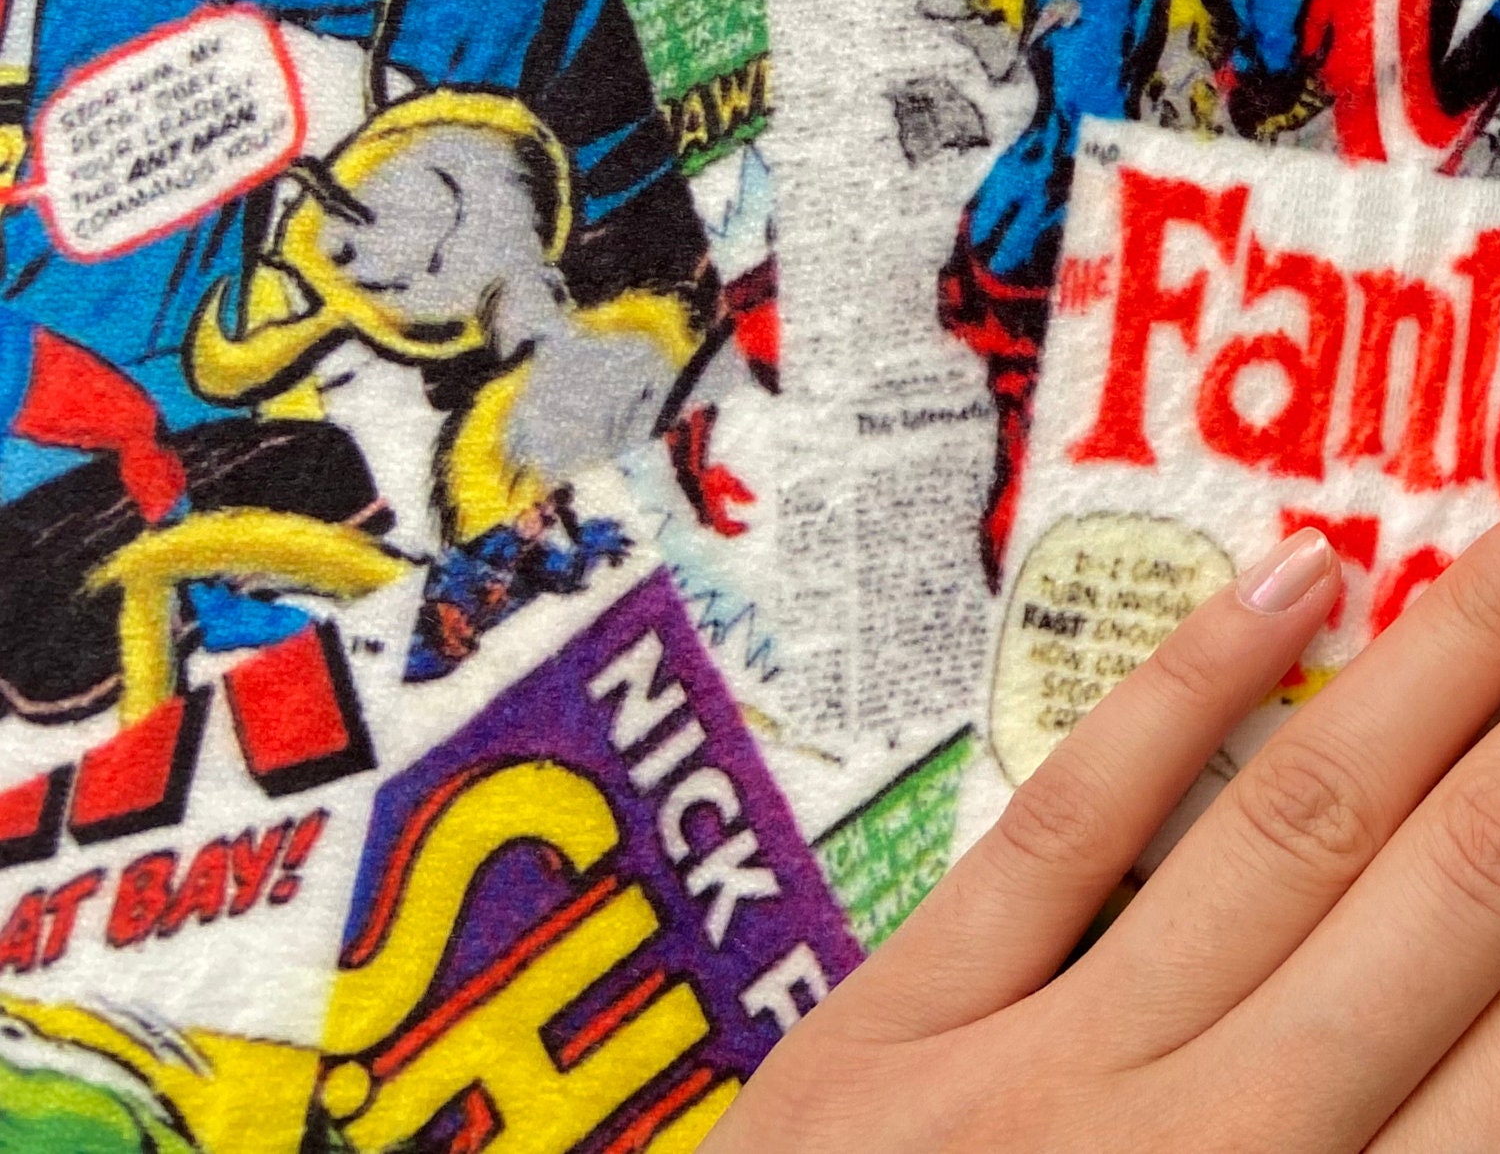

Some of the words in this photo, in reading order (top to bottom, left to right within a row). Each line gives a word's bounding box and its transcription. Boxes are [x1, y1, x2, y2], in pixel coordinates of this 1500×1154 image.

[0, 867, 108, 976] AT
[105, 807, 331, 948] BAY!
[587, 630, 781, 949] NICK
